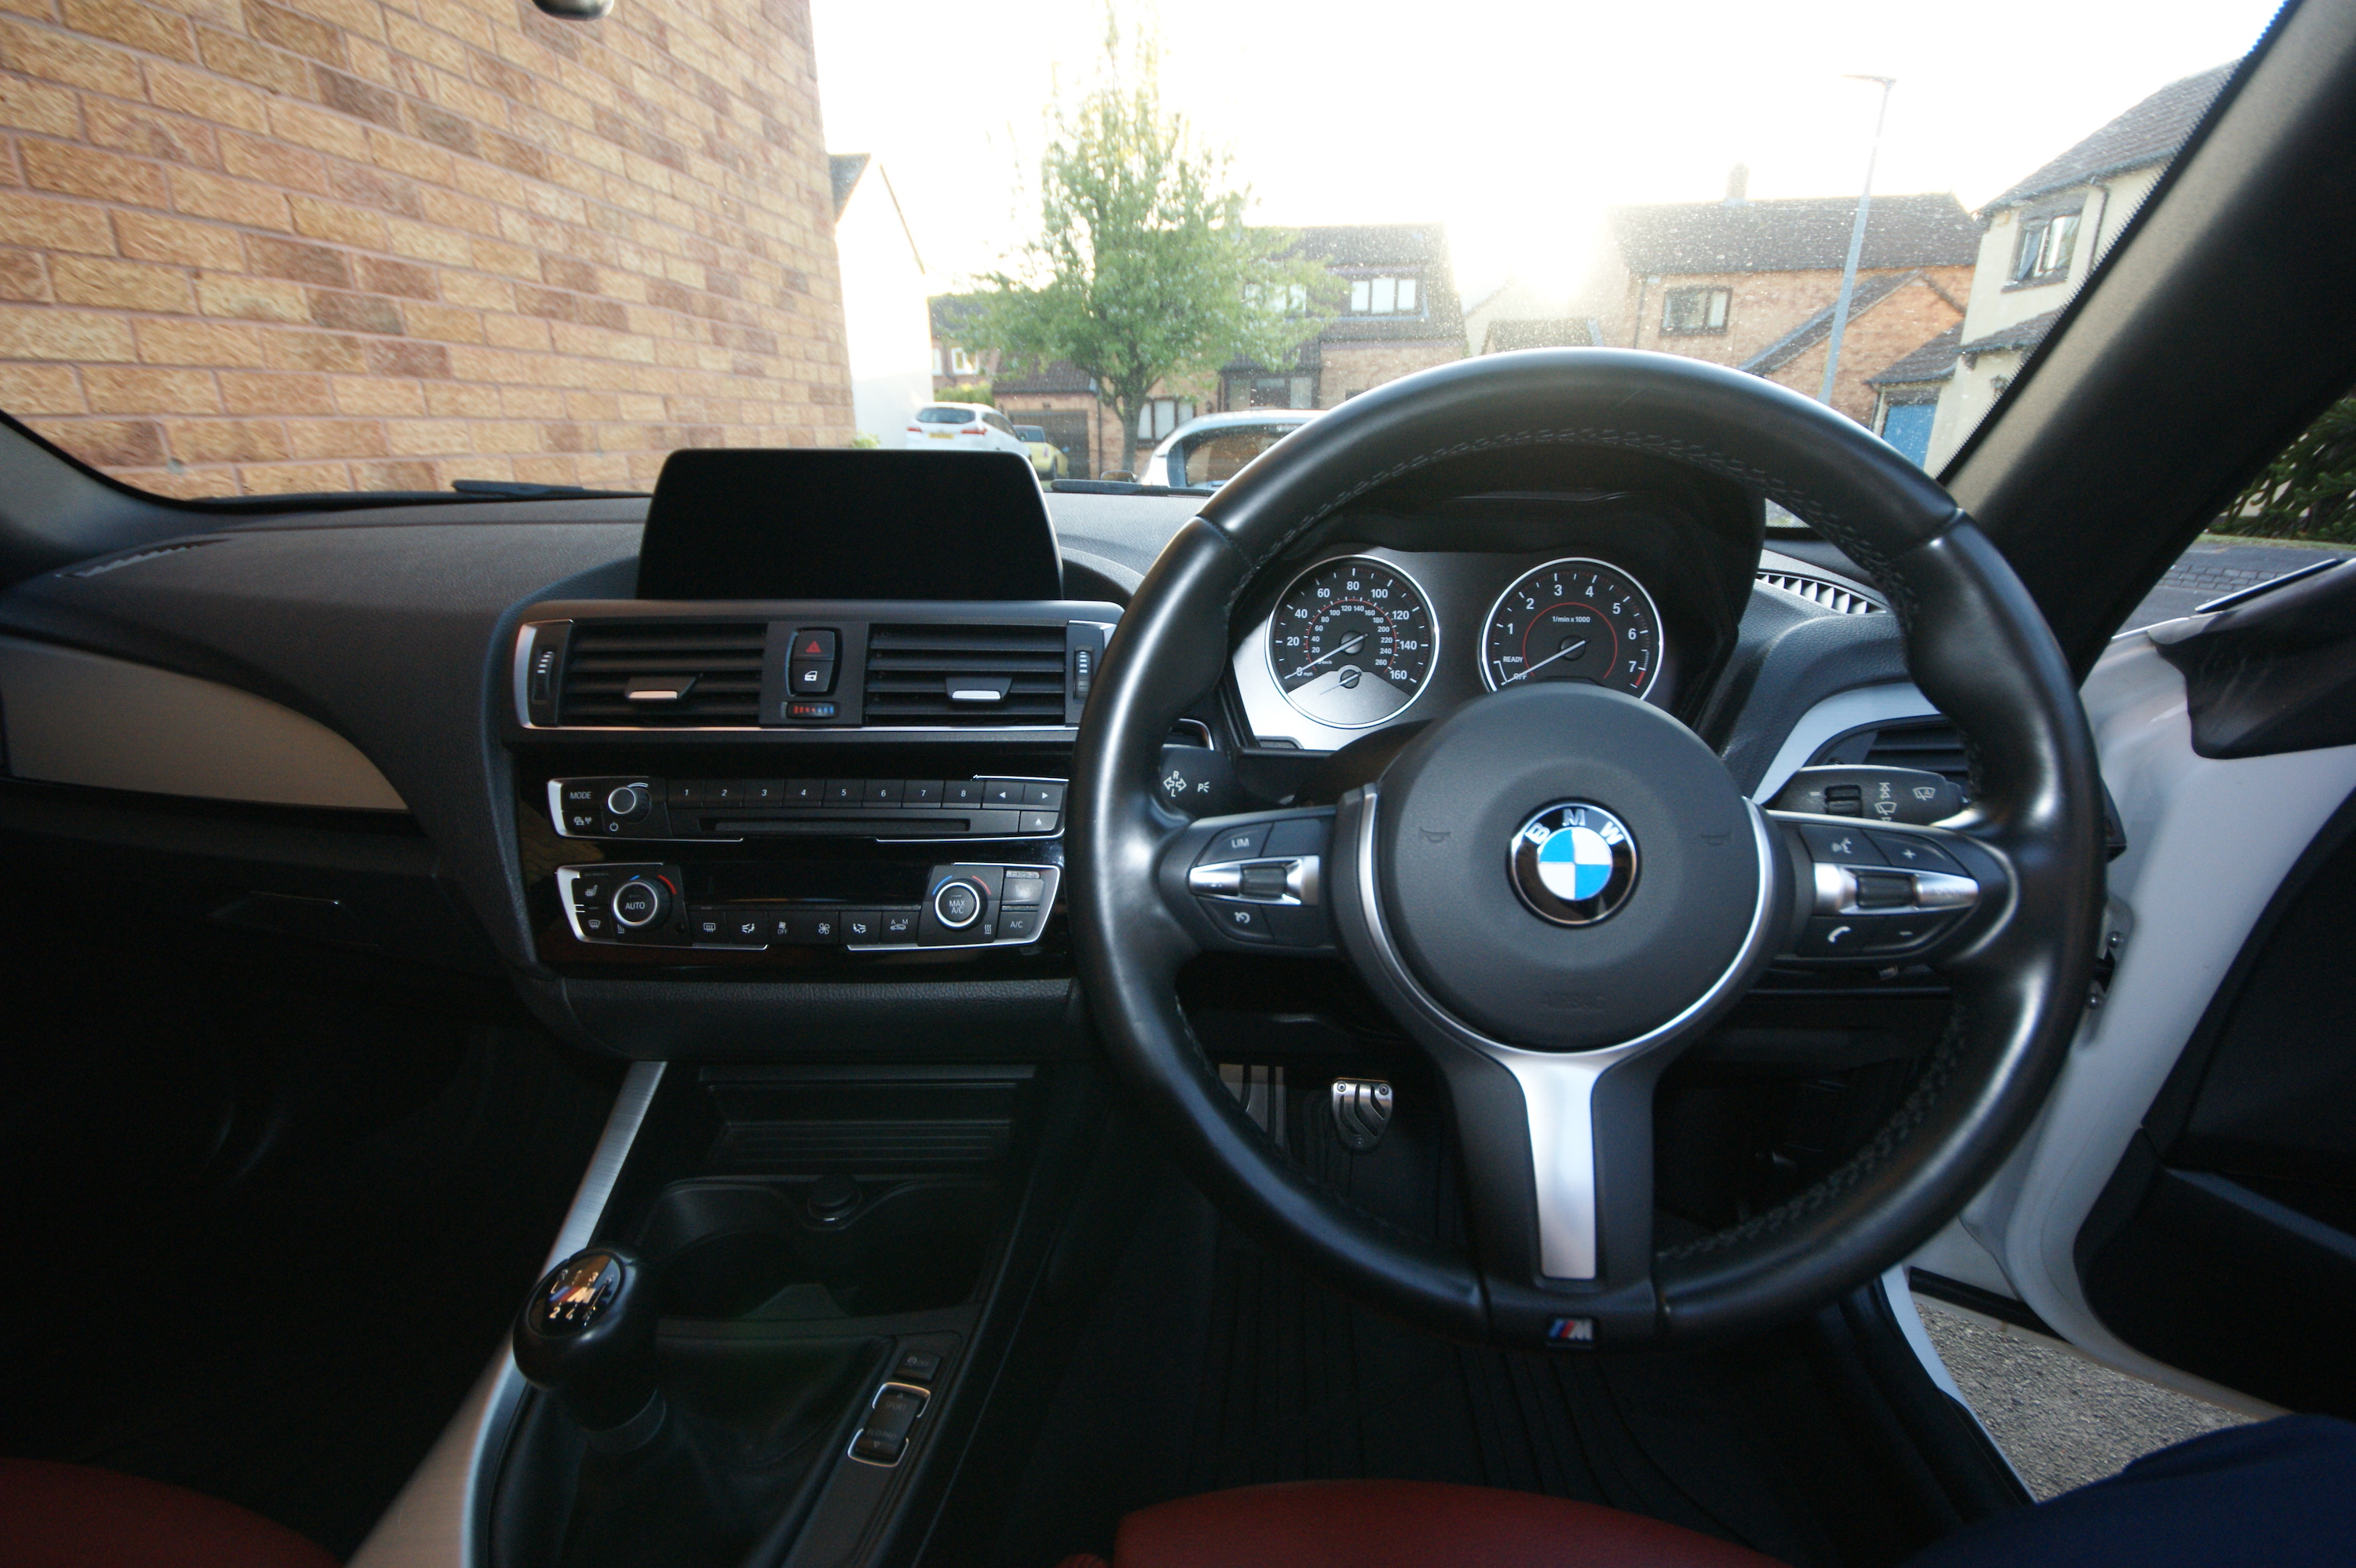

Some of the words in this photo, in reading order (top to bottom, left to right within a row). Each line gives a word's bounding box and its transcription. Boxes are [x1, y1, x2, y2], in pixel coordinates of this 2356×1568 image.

[1346, 580, 1359, 590] 80
[1554, 584, 1563, 596] 3
[1317, 588, 1330, 598] 60
[1370, 589, 1388, 598] 100
[1585, 586, 1593, 597] 4
[1526, 598, 1535, 610] 2
[1612, 603, 1621, 615] 5
[1294, 609, 1308, 619] 40
[1392, 611, 1410, 620] 120
[1507, 623, 1513, 634] 1
[1628, 628, 1637, 640] 6
[1286, 636, 1300, 646] 20
[1399, 640, 1418, 650] 140
[1629, 660, 1637, 672] 7
[1390, 670, 1407, 680] 160
[1173, 770, 1179, 780] R
[1171, 788, 1176, 797] L
[1524, 808, 1624, 846] BMW
[1231, 837, 1249, 849] LIM
[549, 1306, 561, 1319] 2
